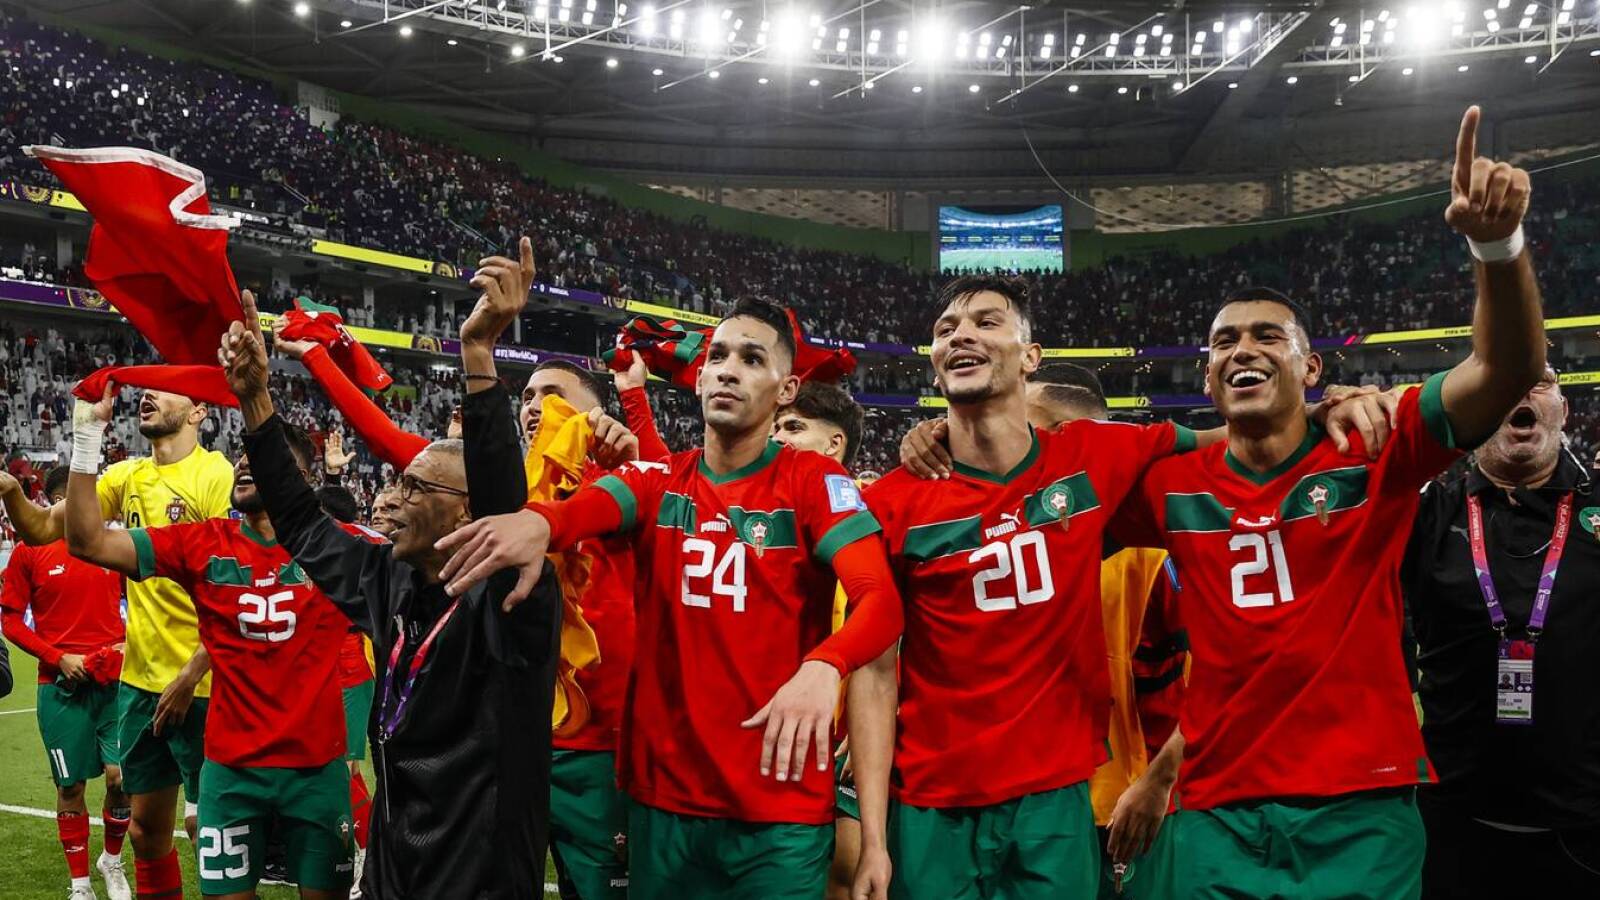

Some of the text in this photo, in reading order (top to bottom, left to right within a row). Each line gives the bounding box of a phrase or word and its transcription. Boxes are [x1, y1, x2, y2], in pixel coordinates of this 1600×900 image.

[700, 520, 727, 532] PUMA
[984, 520, 1017, 540] PUMA
[681, 538, 748, 612] 24
[968, 530, 1055, 612] 20
[1228, 529, 1294, 608] 21
[237, 590, 296, 642] 25
[50, 749, 69, 778] 11
[199, 825, 250, 879] 25
